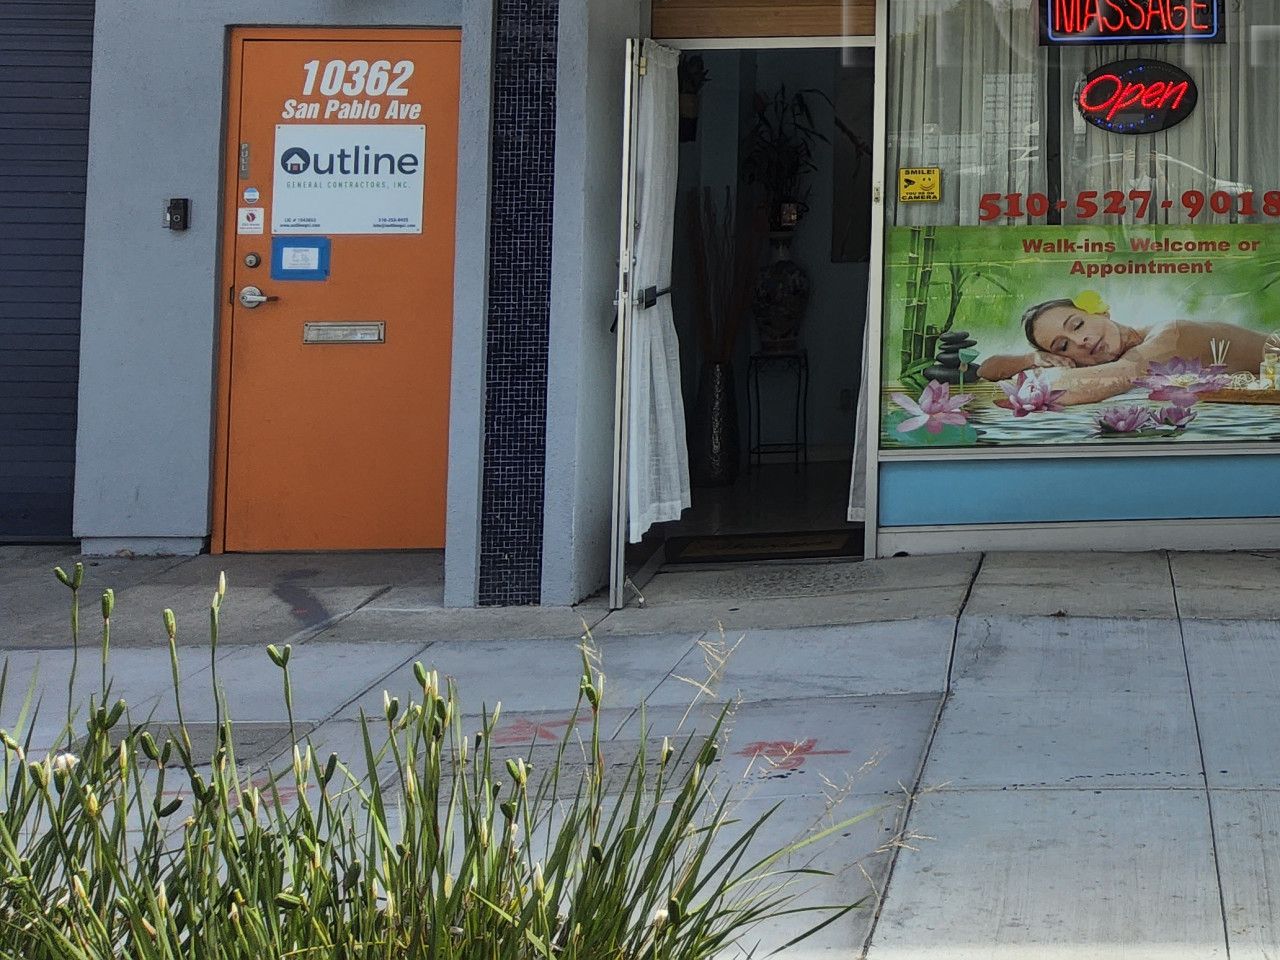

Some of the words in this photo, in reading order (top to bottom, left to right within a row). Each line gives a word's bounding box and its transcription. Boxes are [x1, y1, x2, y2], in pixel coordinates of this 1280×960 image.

[302, 59, 415, 97] 10362
[1079, 73, 1189, 121] Open
[281, 98, 320, 120] San
[324, 98, 381, 120] Pablo
[384, 99, 422, 120] Ave
[280, 145, 419, 176] Outline
[286, 180, 323, 189] GENERAL
[1021, 238, 1117, 254] Walk-ins
[1129, 238, 1231, 253] Welcome
[1237, 239, 1261, 253] or
[1070, 258, 1214, 279] Appointment
